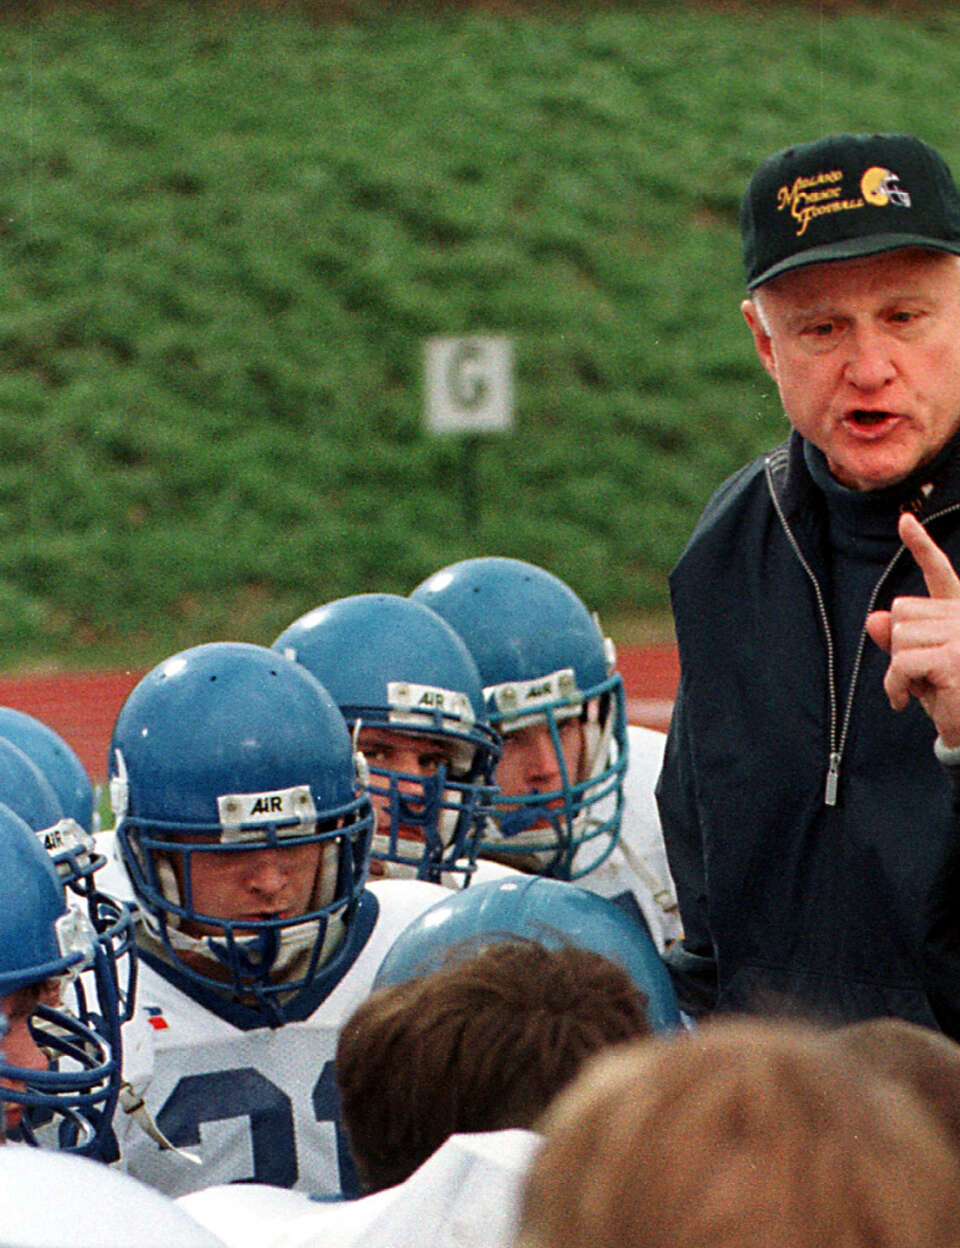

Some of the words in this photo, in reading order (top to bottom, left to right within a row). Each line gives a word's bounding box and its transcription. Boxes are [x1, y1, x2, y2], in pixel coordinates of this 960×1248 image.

[446, 341, 489, 413] G
[418, 691, 445, 711] AIR
[249, 796, 283, 815] AIR
[44, 830, 64, 850] AIR
